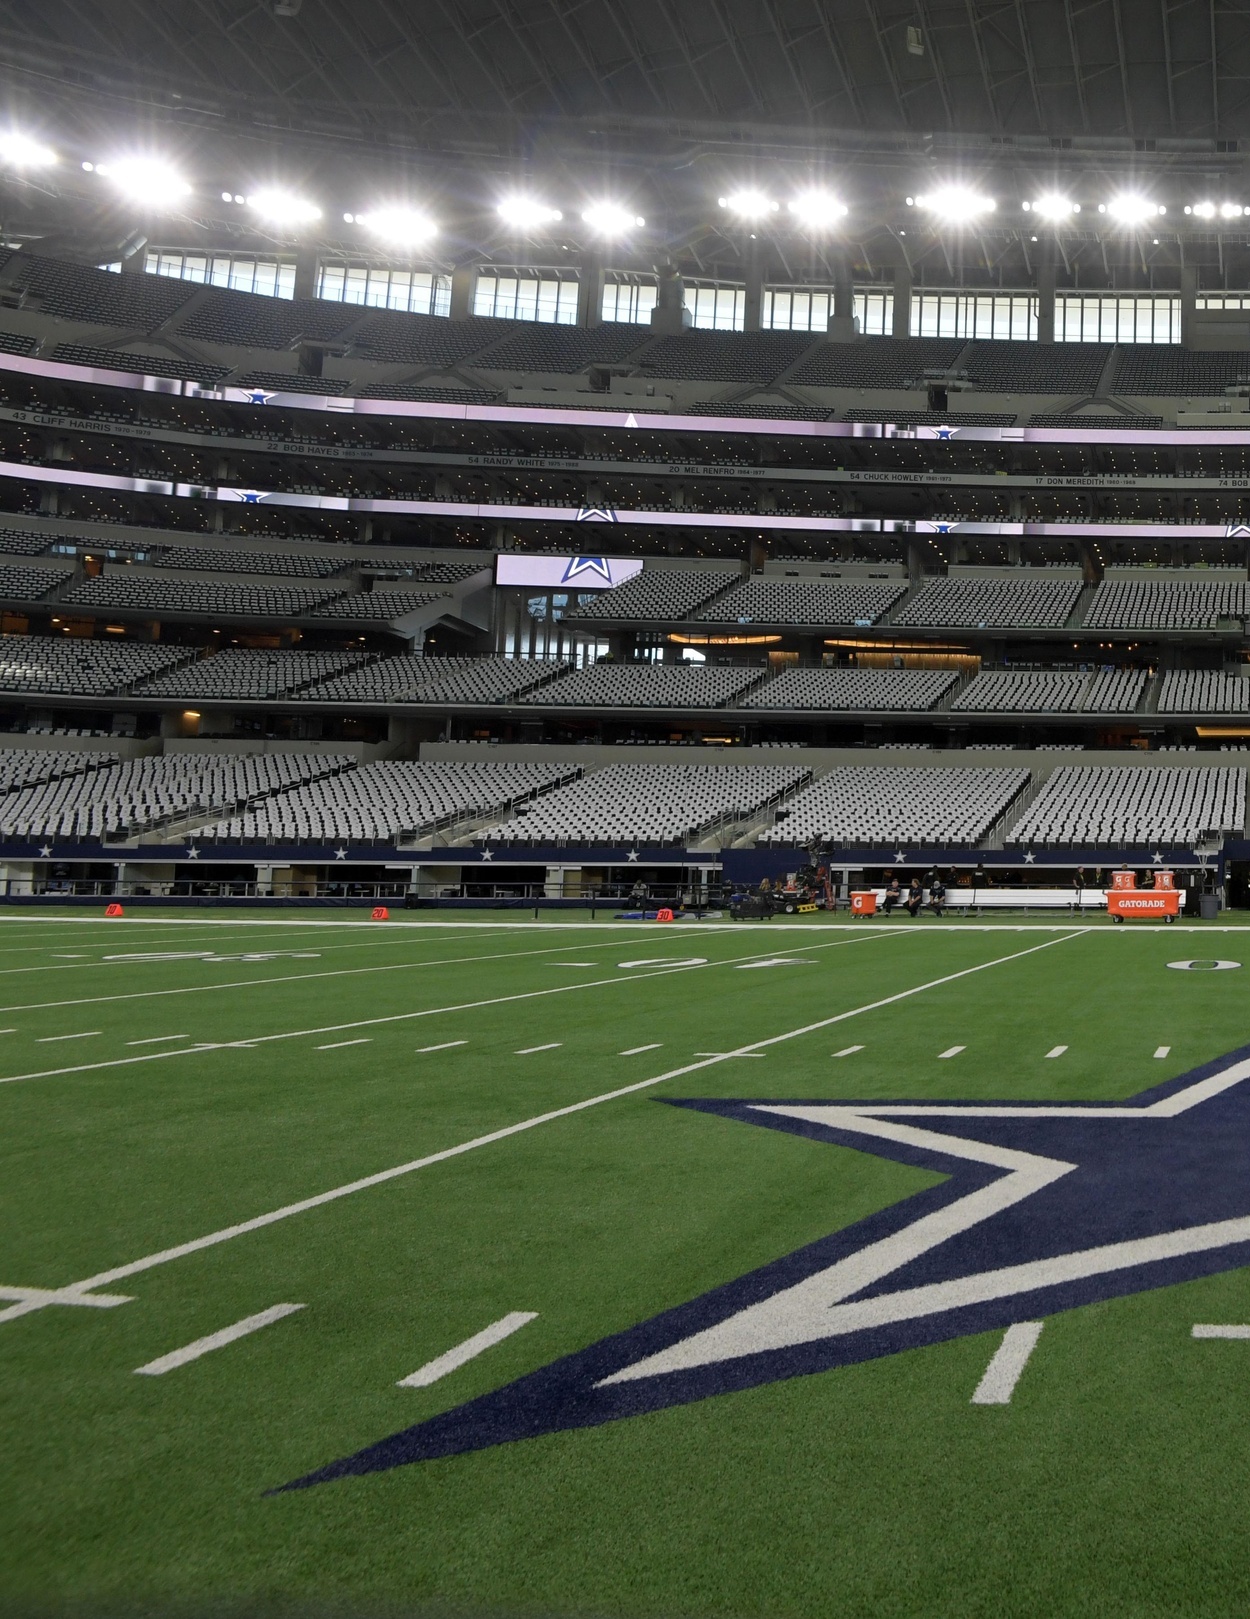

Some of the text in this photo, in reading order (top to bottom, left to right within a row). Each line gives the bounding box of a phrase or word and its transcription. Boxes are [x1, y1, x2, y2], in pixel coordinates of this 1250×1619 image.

[12, 412, 26, 421] 43
[33, 415, 65, 426] CLIFF
[69, 420, 111, 432] HARRIS
[284, 444, 304, 453] BOB
[307, 447, 339, 456] HAYES
[483, 457, 513, 465] RANDY
[684, 466, 700, 474] MEL
[703, 467, 735, 475] RENFRO
[864, 473, 889, 481] CHUCK
[892, 474, 923, 482] HOWLEY
[1066, 478, 1104, 486] MEREDITH
[853, 896, 862, 908] G
[1119, 900, 1165, 908] GATORADE
